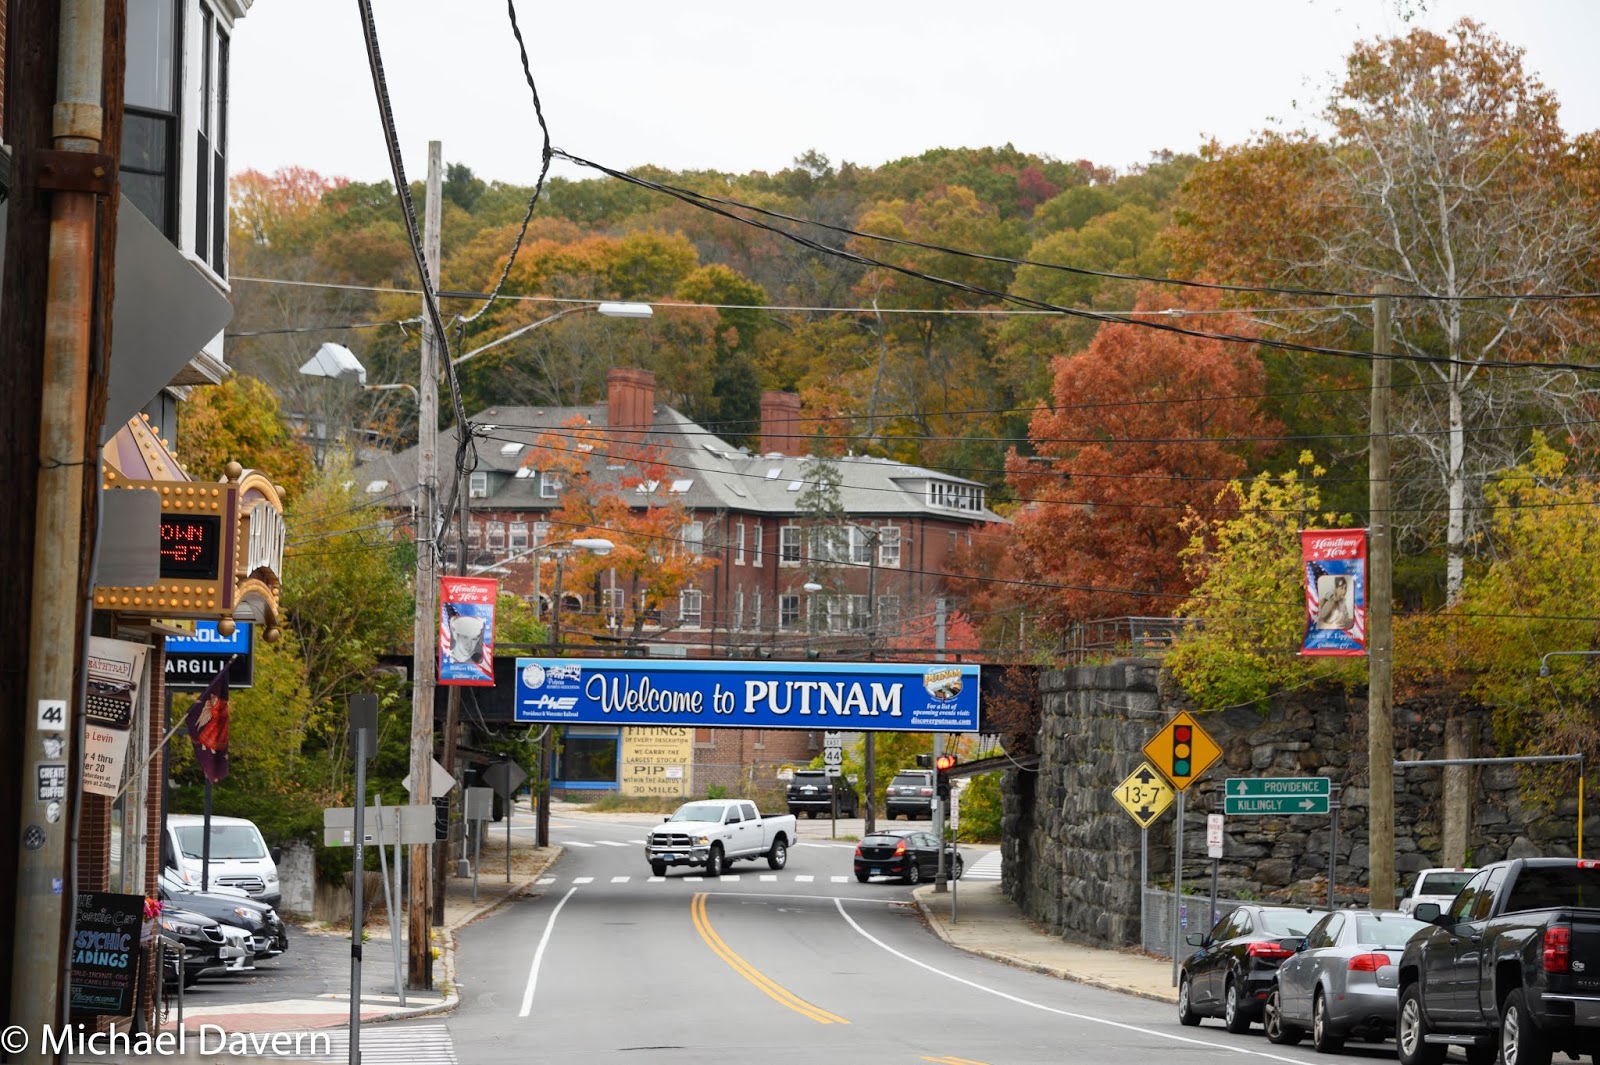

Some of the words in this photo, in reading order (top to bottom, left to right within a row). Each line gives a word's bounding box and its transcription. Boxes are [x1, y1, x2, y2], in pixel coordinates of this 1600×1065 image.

[159, 525, 203, 541] OWN
[1312, 537, 1358, 550] Hometown
[449, 584, 488, 594] Hometown
[585, 673, 703, 713] Welcome
[713, 683, 735, 714] to
[744, 680, 903, 716] PUTNAM
[42, 707, 62, 723] 44
[911, 717, 971, 725] discoverputnam.com
[628, 726, 686, 736] FITTINGS
[92, 731, 113, 744] Levin
[90, 752, 96, 761] 4
[97, 753, 114, 764] thru
[826, 752, 840, 761] 44
[40, 767, 65, 779] CREATE
[95, 763, 106, 773] 20
[634, 766, 665, 775] PIP
[99, 781, 117, 790] 2:00pm
[649, 786, 679, 794] MILES
[1264, 782, 1319, 792] PROVIDENCE
[1238, 800, 1282, 810] KILLINGLY
[77, 894, 93, 908] HE
